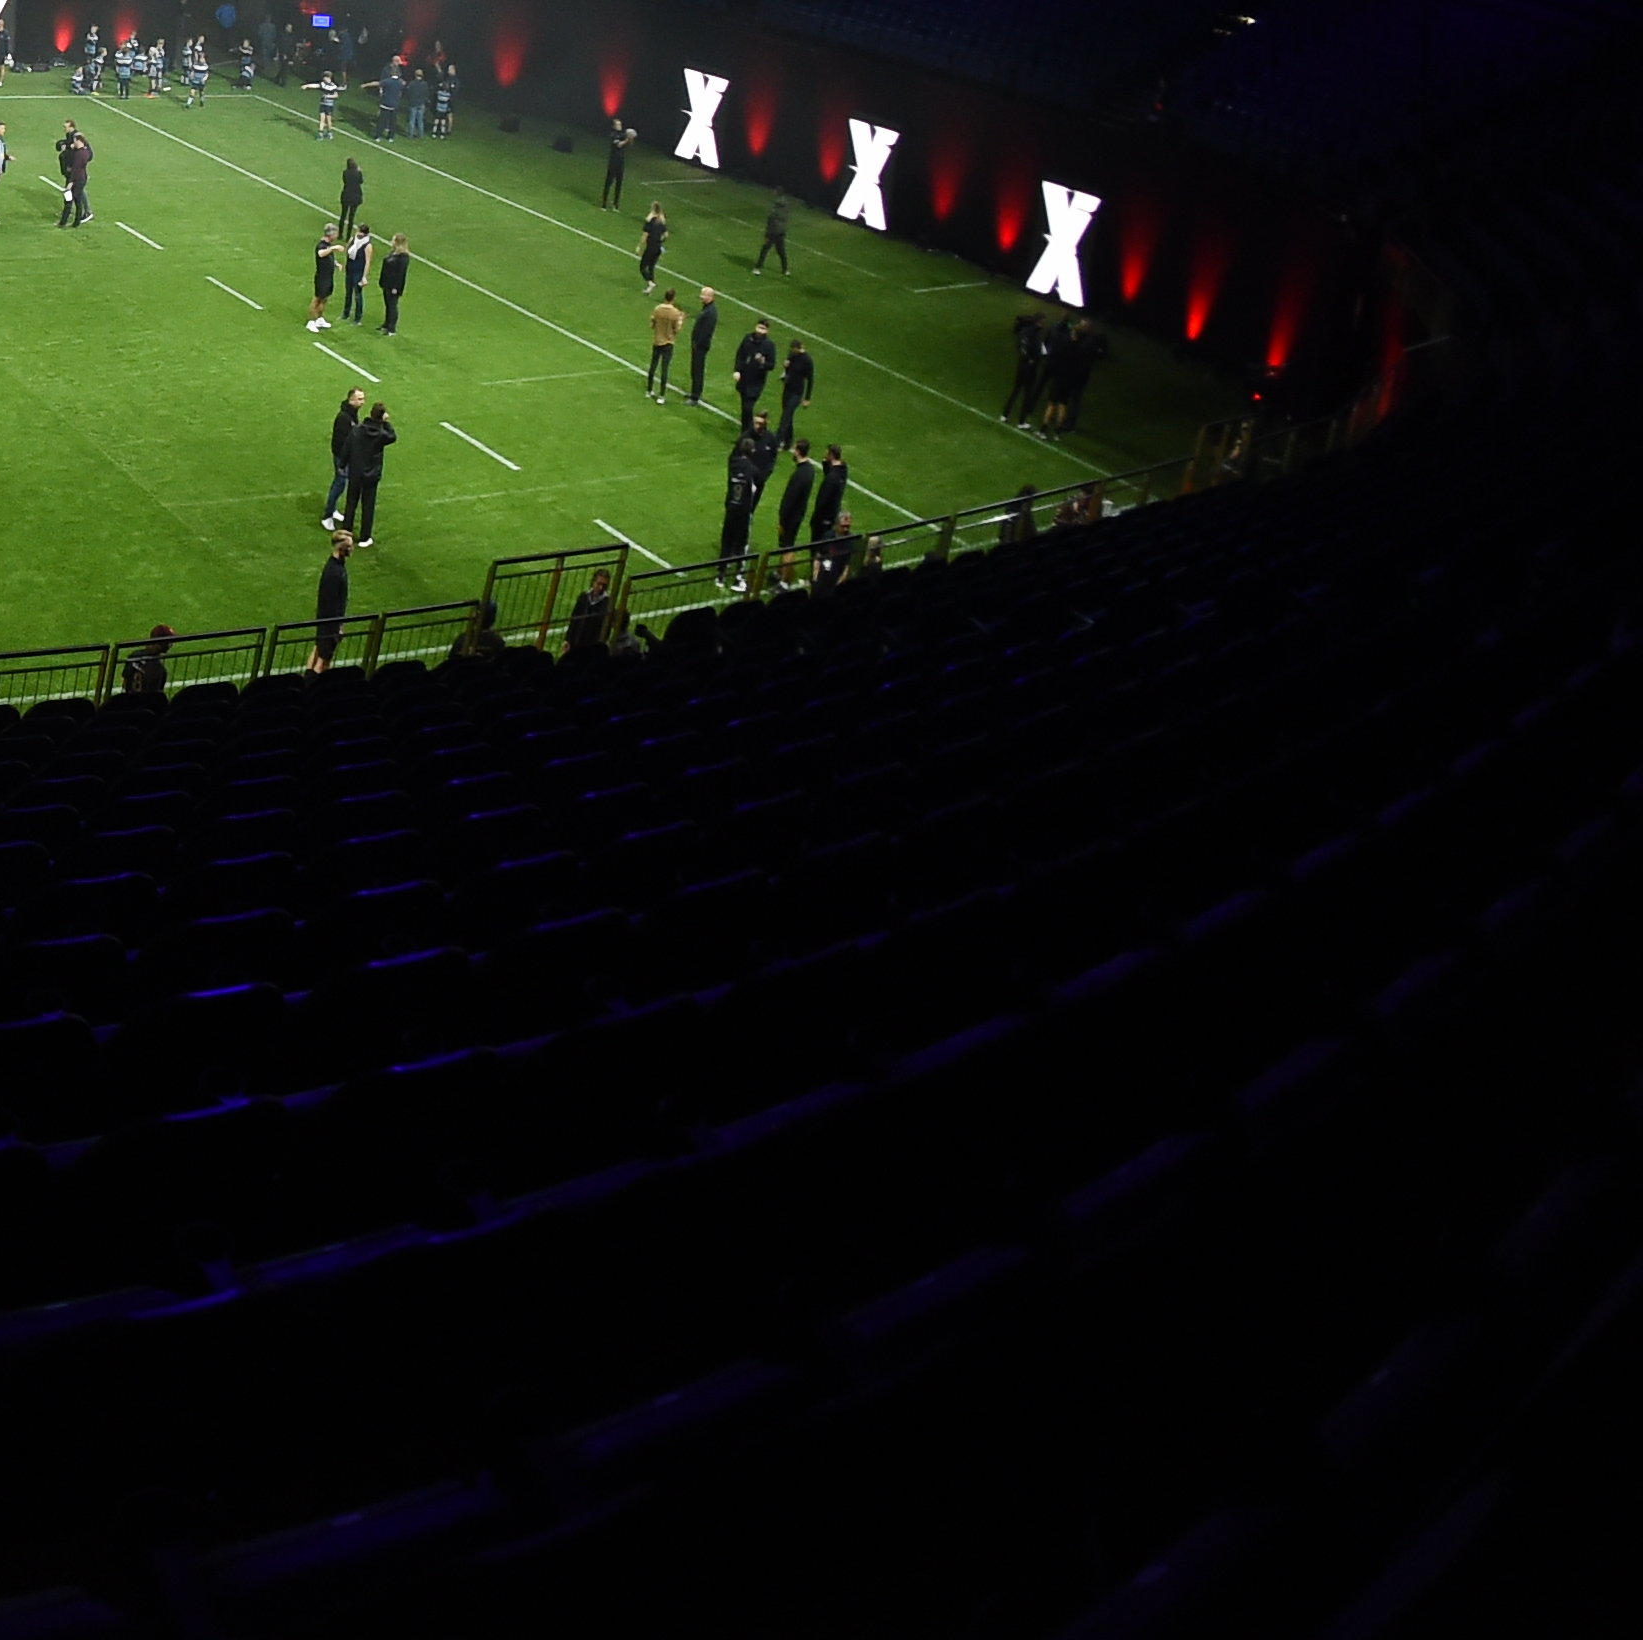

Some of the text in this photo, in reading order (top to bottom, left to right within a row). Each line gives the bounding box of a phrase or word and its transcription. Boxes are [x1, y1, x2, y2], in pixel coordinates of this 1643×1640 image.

[675, 68, 729, 168] X
[837, 119, 899, 230] X
[1026, 181, 1101, 307] X
